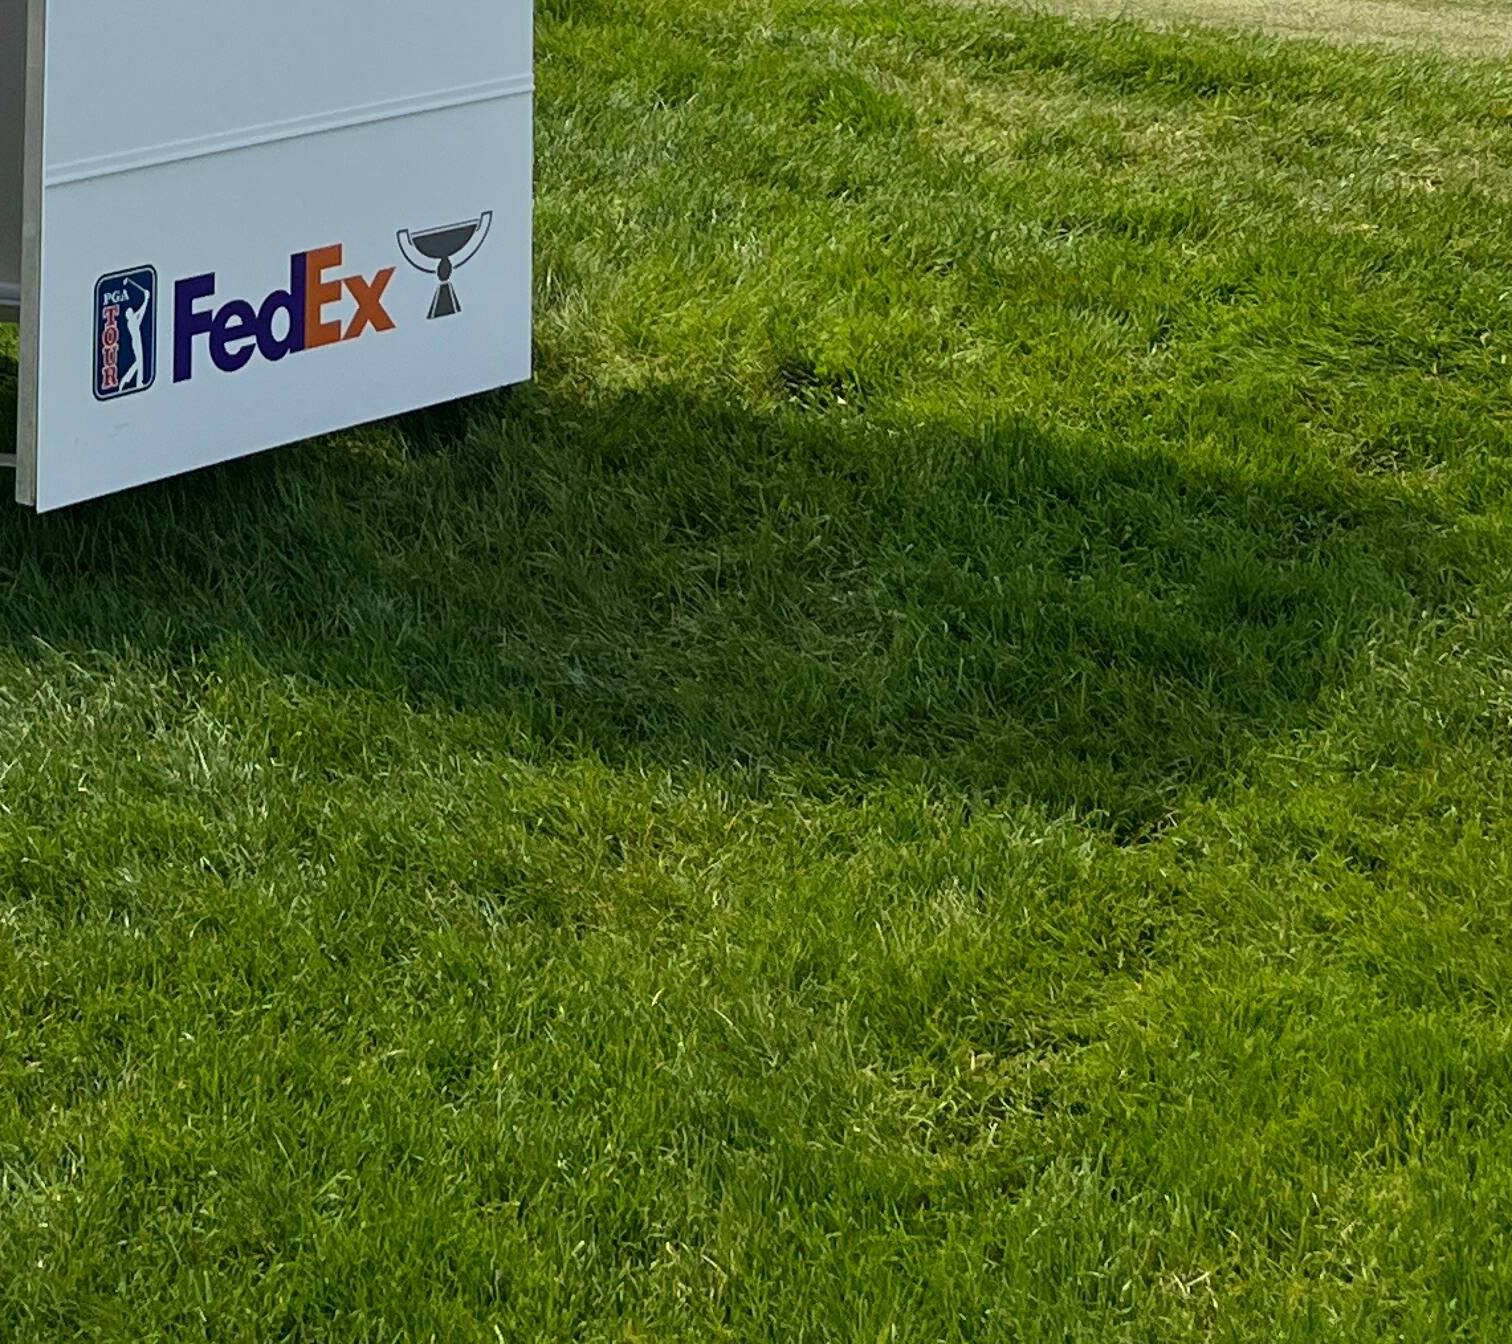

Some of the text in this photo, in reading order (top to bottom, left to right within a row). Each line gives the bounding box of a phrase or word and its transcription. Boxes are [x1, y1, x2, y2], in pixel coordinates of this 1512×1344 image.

[103, 288, 130, 306] PGA
[172, 242, 397, 384] FedEx
[101, 304, 120, 390] TOUR
